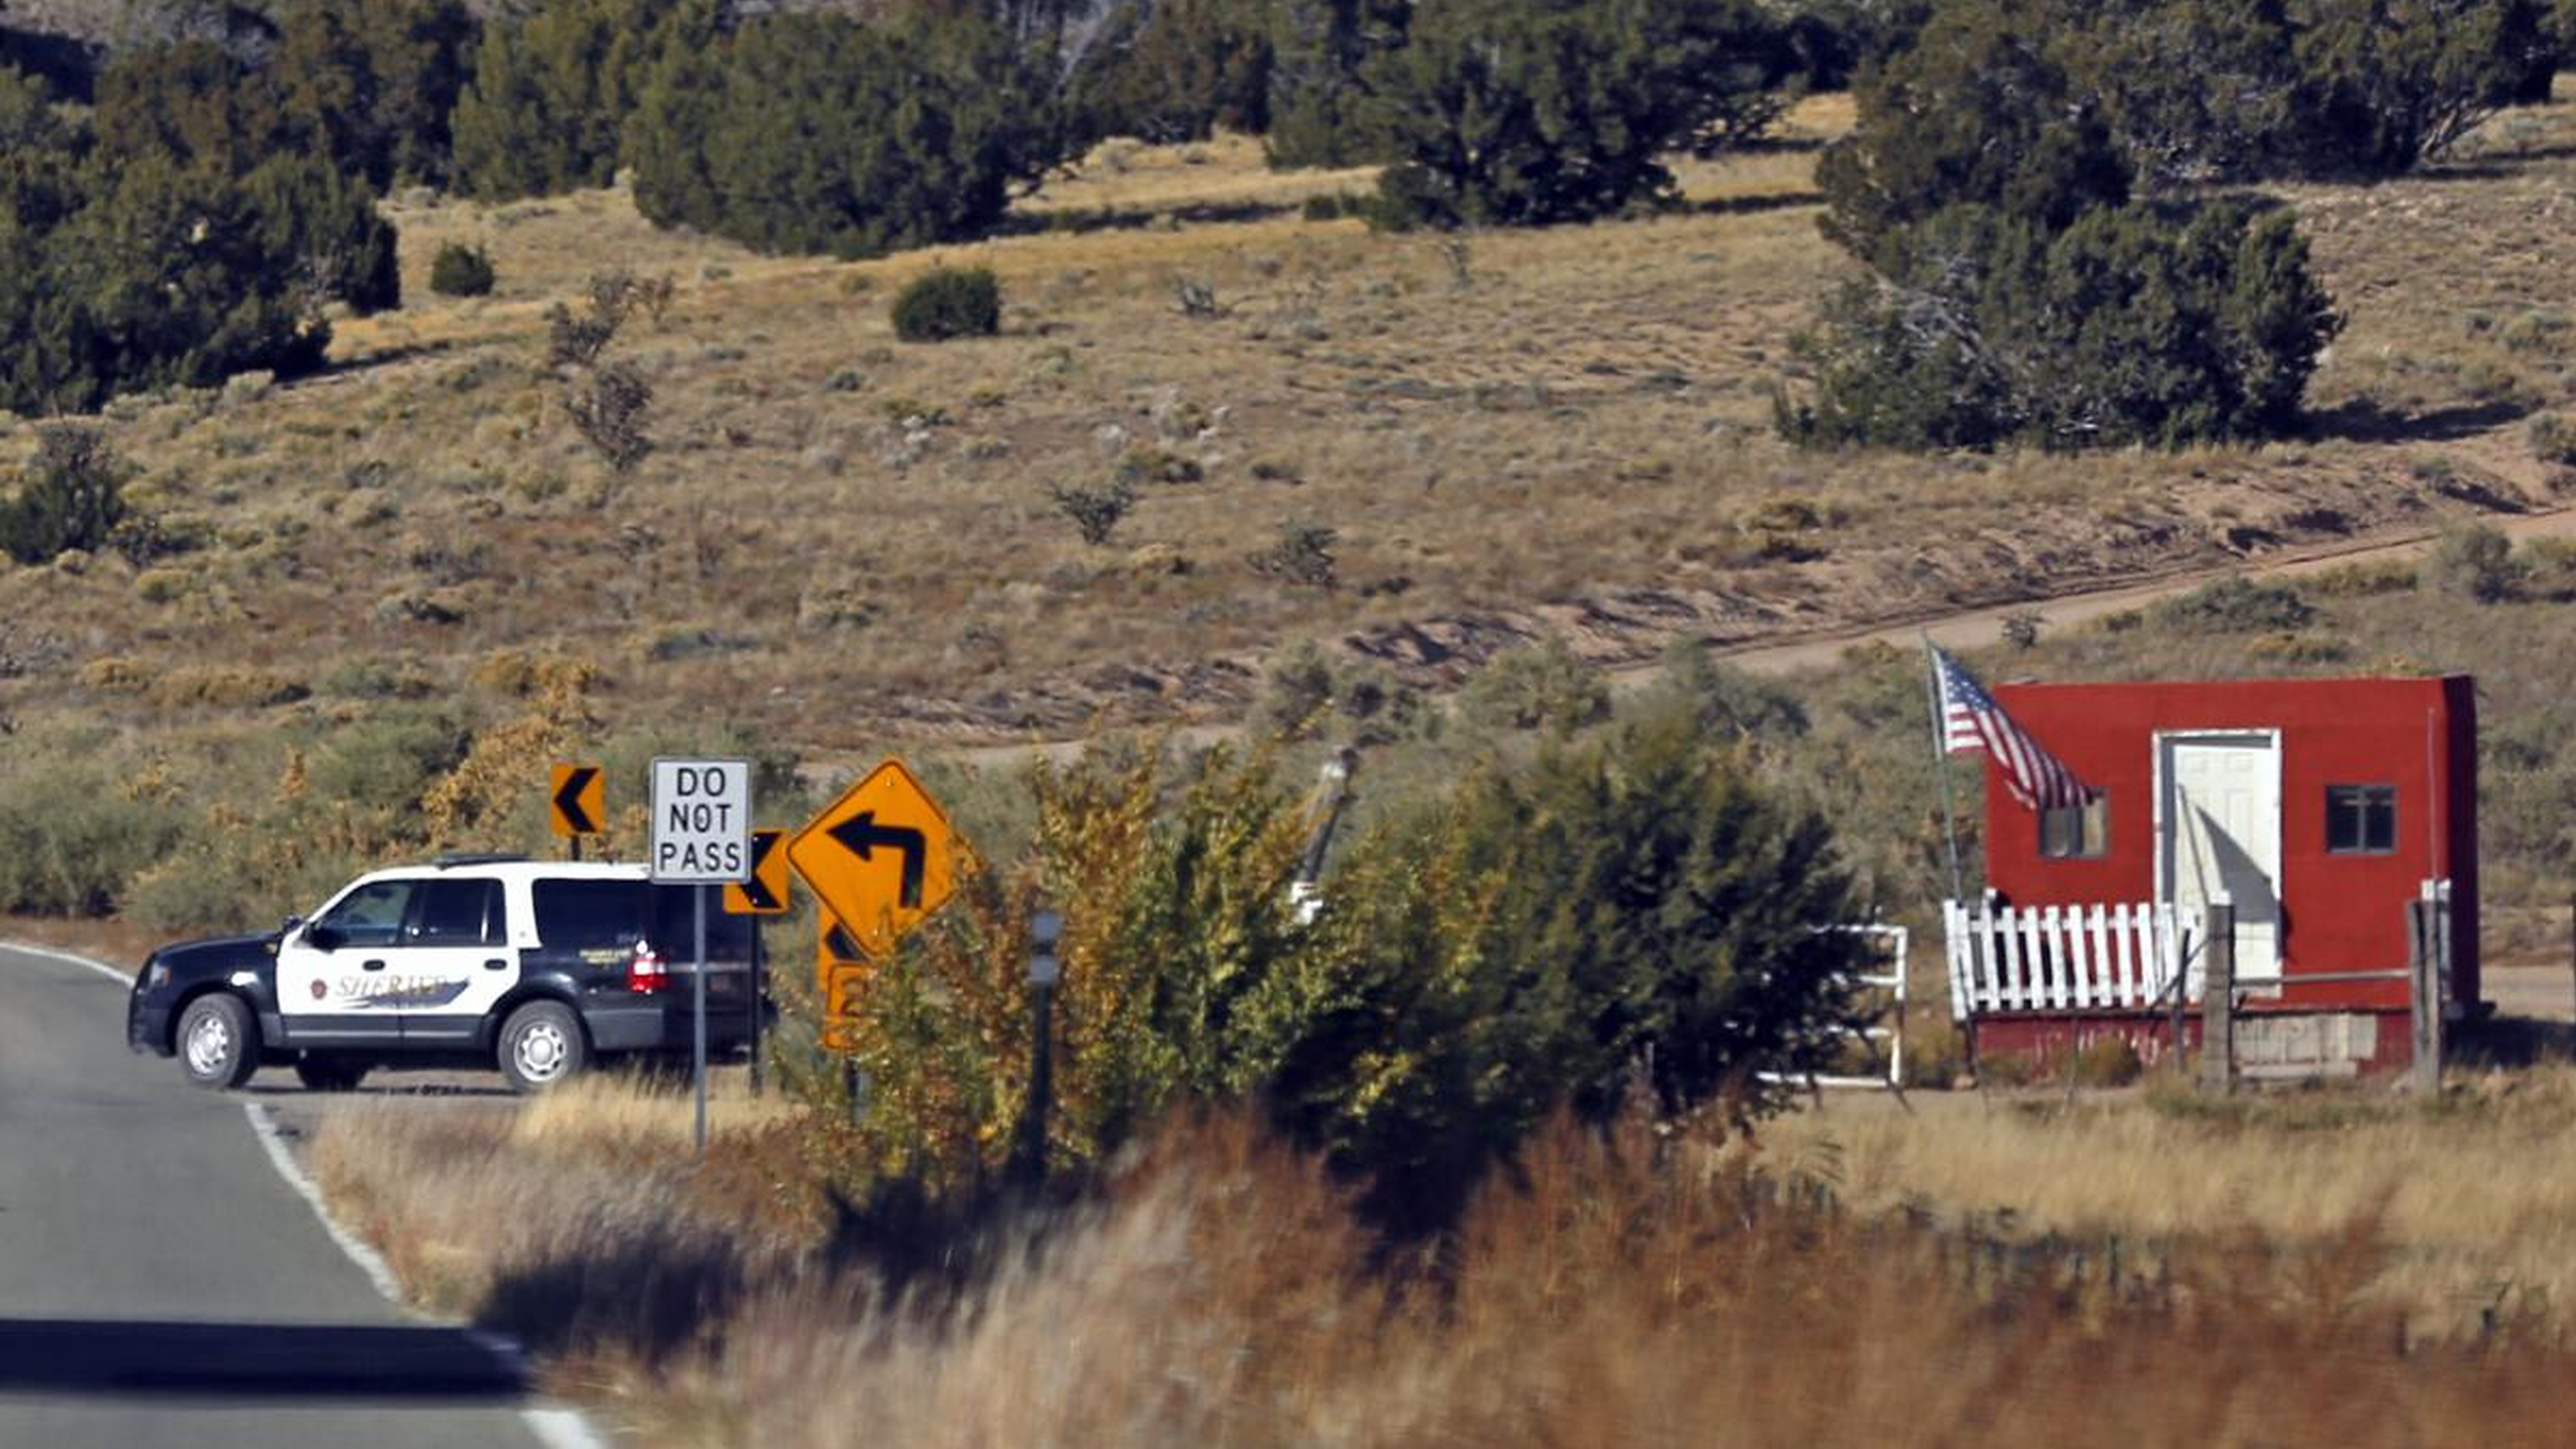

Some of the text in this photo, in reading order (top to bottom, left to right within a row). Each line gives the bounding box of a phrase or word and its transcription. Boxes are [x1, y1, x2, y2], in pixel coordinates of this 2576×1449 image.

[677, 767, 726, 796] DO
[669, 804, 732, 832] NOT
[659, 842, 741, 872] PASS
